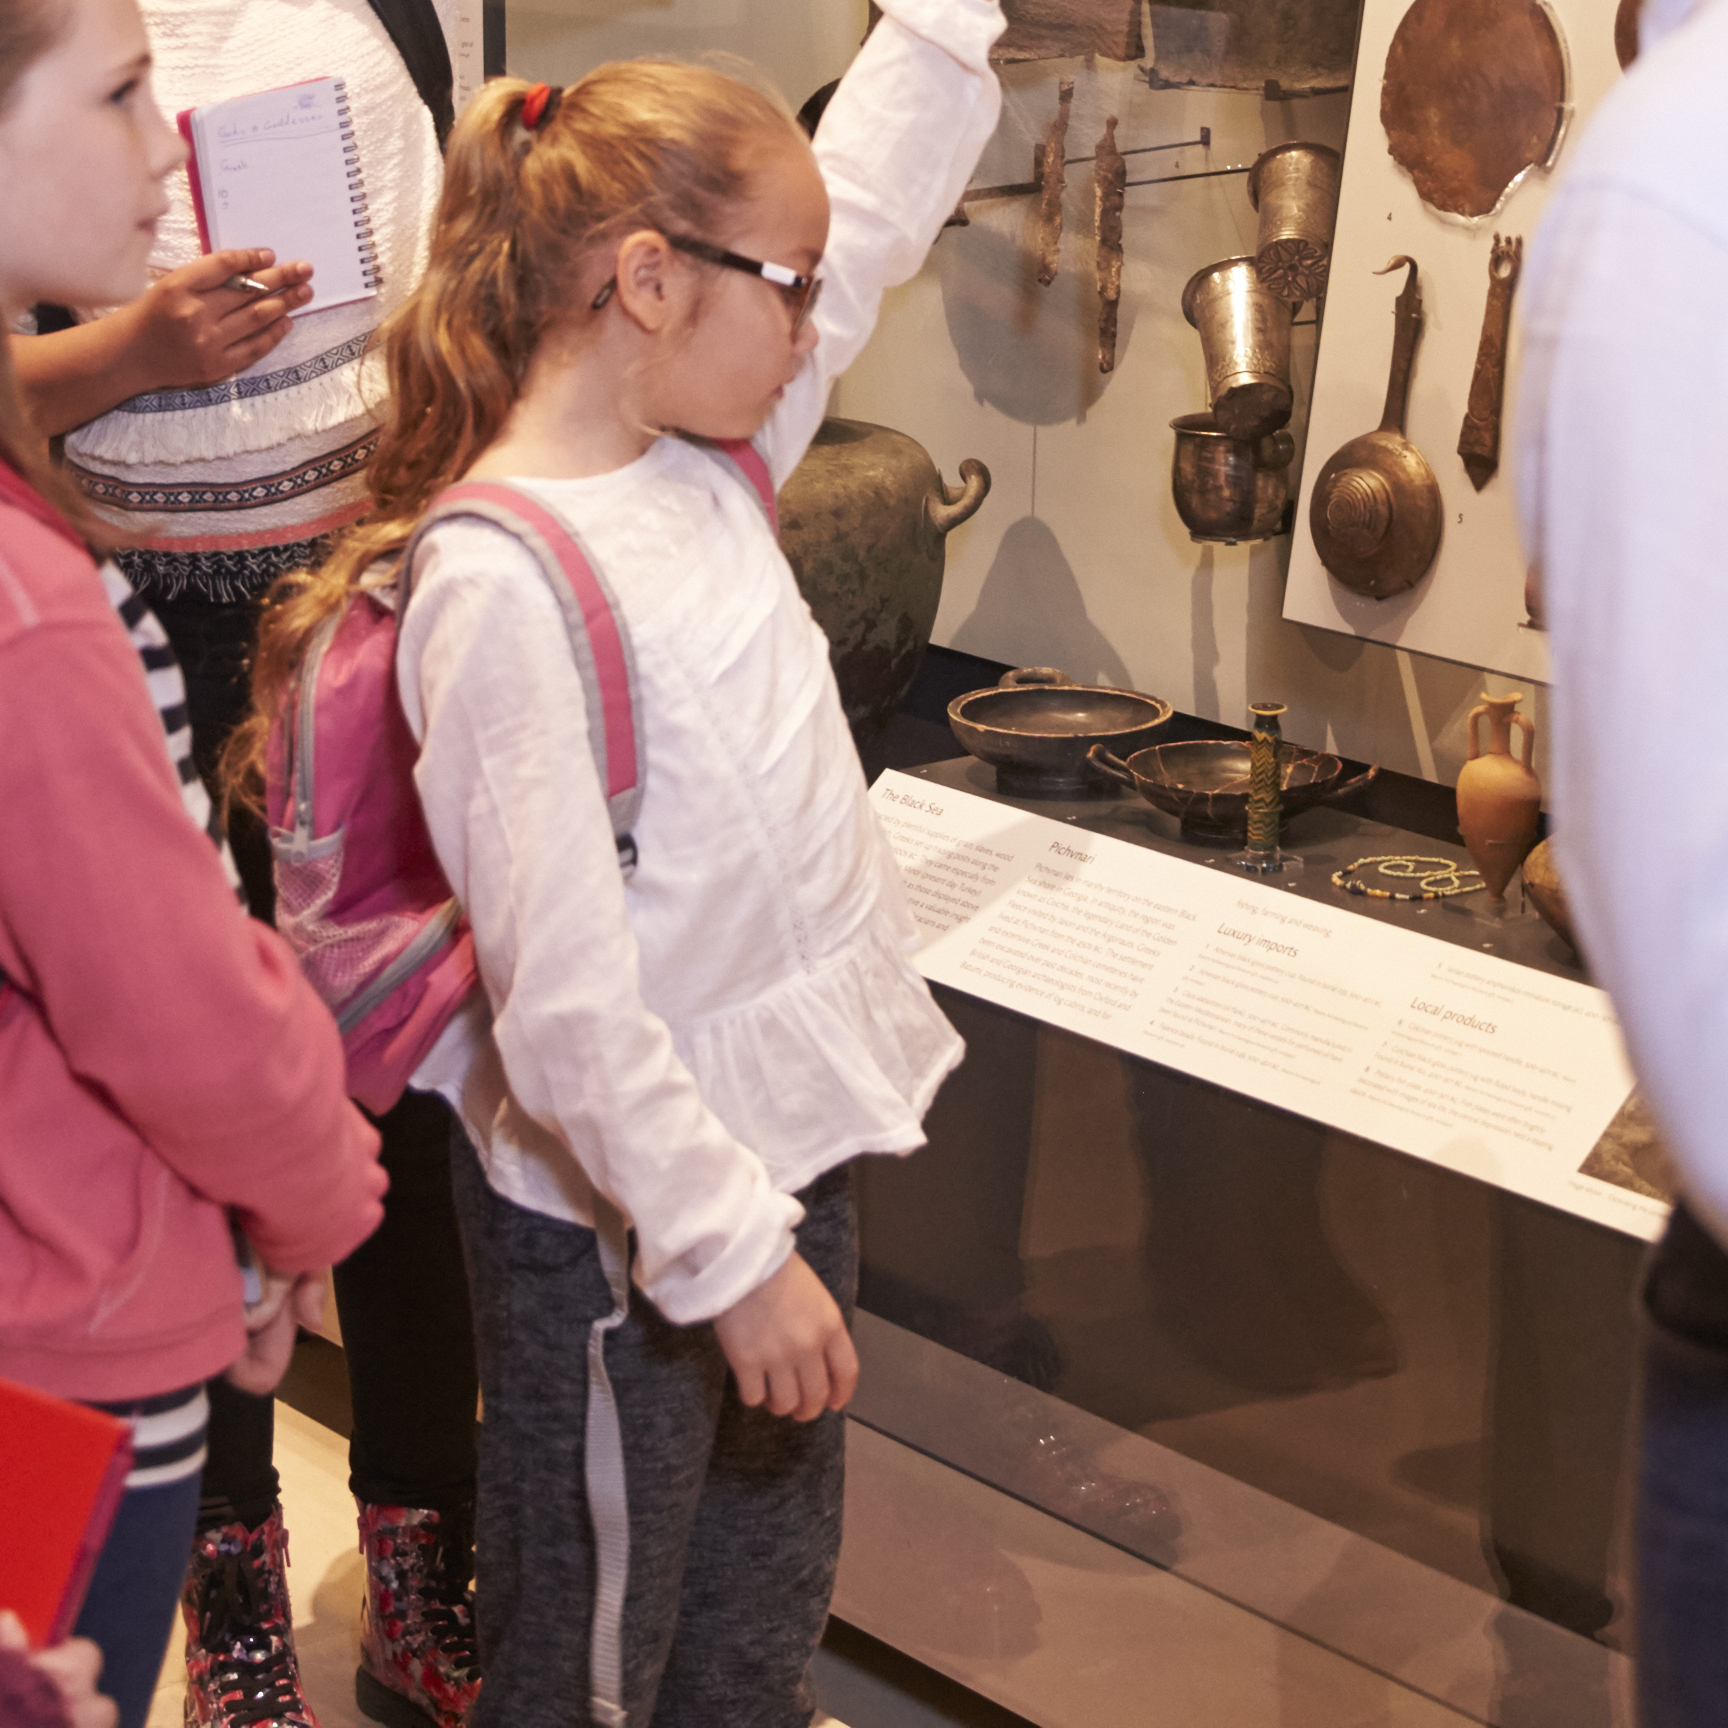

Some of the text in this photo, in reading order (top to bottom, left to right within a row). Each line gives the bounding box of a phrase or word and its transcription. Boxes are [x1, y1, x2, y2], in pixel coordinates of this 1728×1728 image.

[882, 788, 944, 817] The Black Sea
[1217, 922, 1299, 958] Luxury imports
[1410, 997, 1498, 1035] Local products
